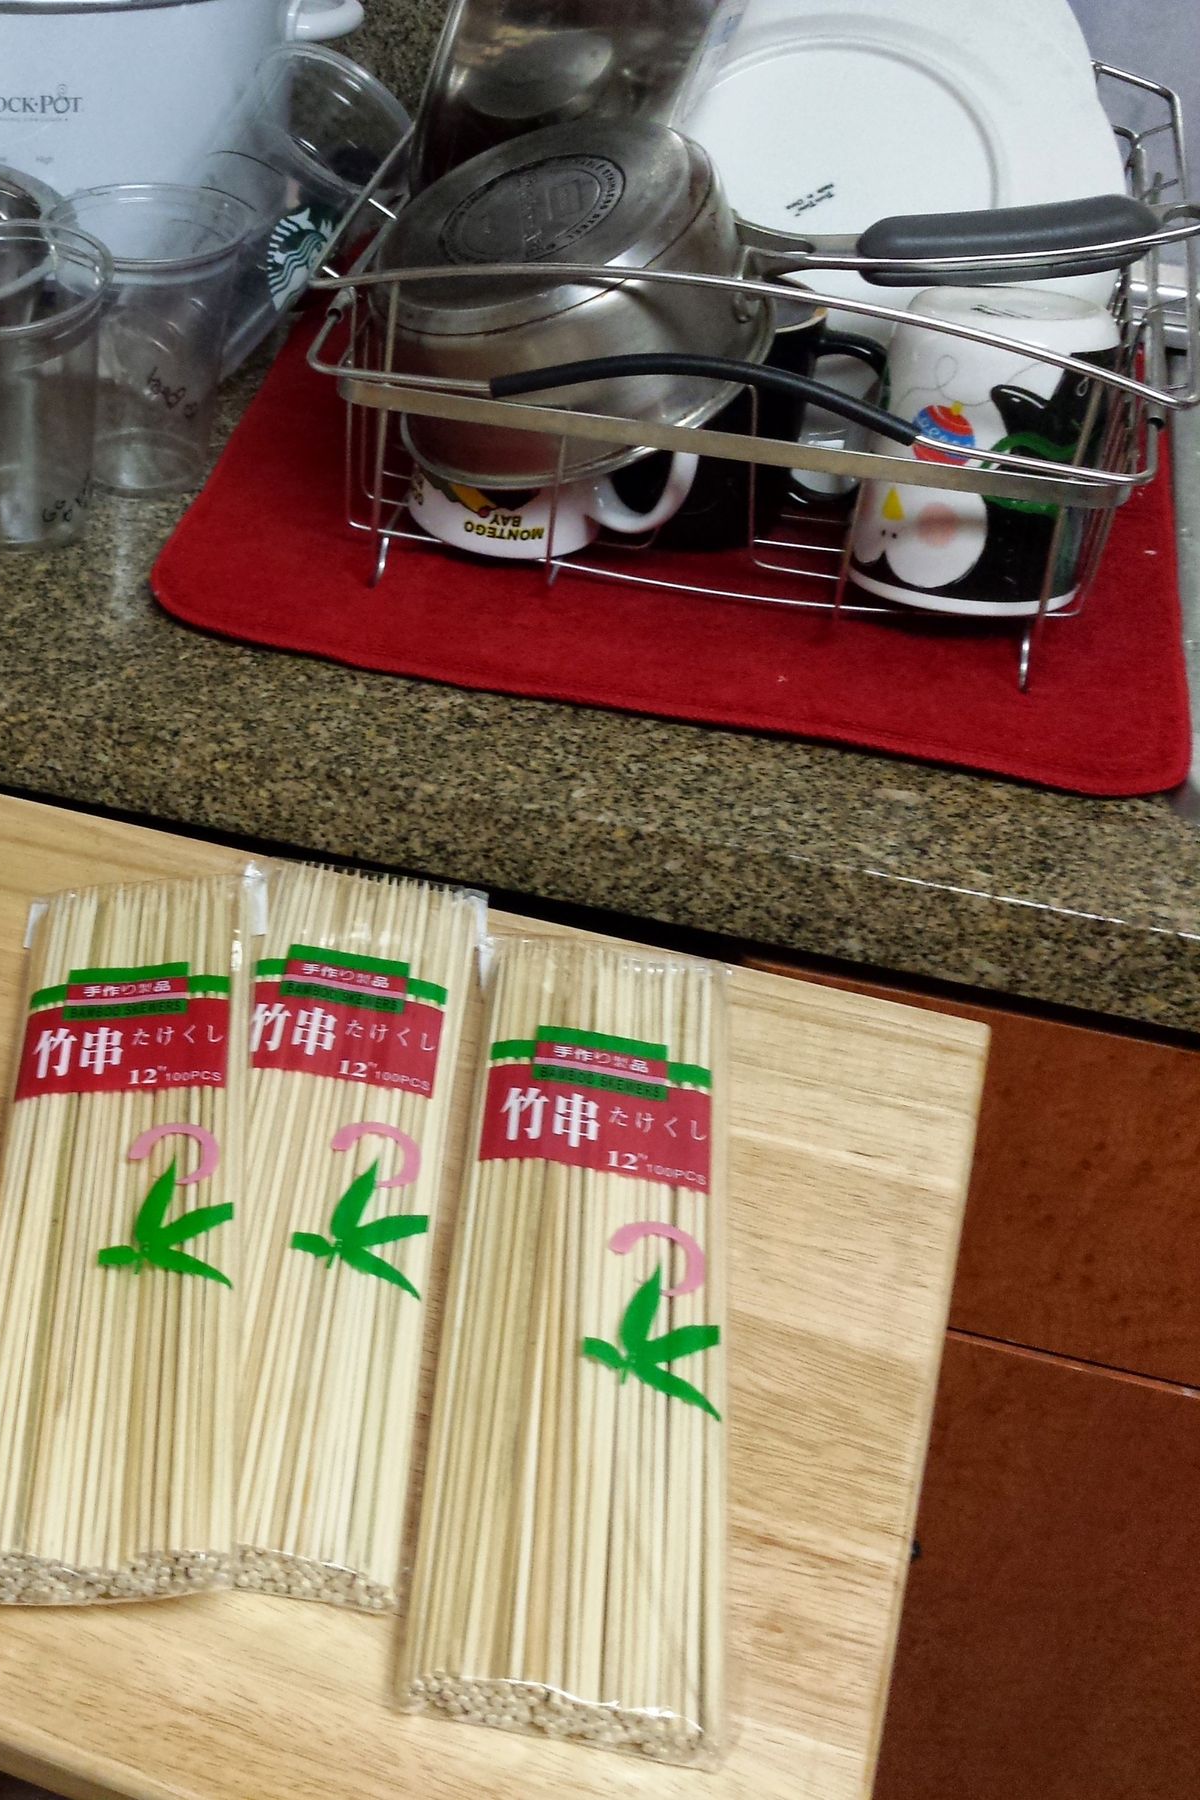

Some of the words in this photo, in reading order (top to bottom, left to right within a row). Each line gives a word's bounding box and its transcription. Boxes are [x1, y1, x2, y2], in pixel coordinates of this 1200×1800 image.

[490, 513, 522, 527] BAY
[464, 521, 544, 541] MONTEGO
[302, 963, 389, 989] 手作り製品
[83, 980, 172, 998] 手作り製品
[286, 981, 336, 1001] BAMBOO
[70, 1004, 119, 1019] BAMBOO
[125, 1000, 182, 1016] SKEWERS
[251, 1002, 338, 1056] 竹串
[344, 1018, 436, 1052] たけくし
[32, 1026, 124, 1080] 竹串
[131, 1024, 224, 1047] たけくし
[553, 1045, 649, 1074] 手作り製品
[165, 1070, 222, 1082] 100PCS
[375, 1071, 431, 1092] 100PCS
[541, 1066, 593, 1085] BAMBOO
[599, 1076, 660, 1098] SKEWERS
[500, 1086, 601, 1148] 竹串
[608, 1105, 708, 1141] たけくし
[645, 1164, 707, 1186] 100PCS
